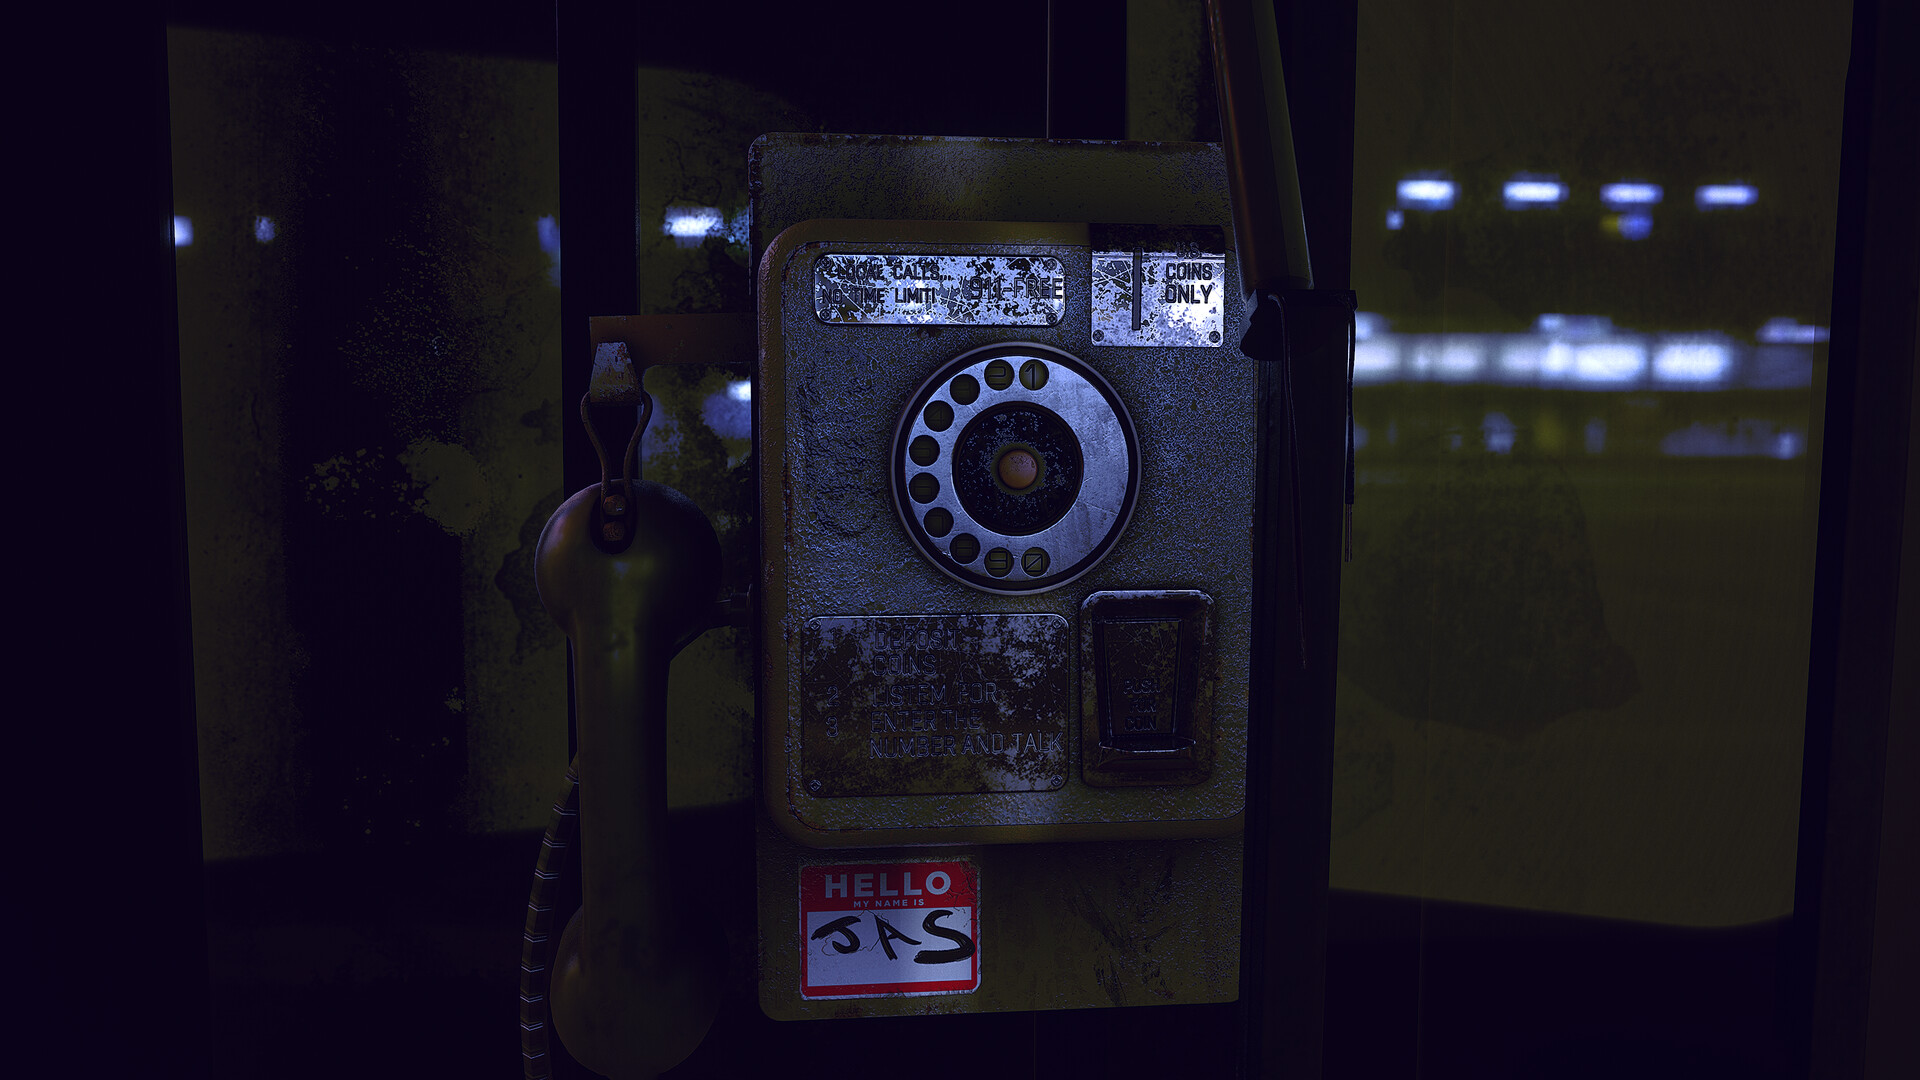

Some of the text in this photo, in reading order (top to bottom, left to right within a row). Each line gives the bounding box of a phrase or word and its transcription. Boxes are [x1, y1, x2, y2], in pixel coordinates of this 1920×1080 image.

[837, 264, 884, 280] LOCAL
[1166, 263, 1213, 280] COINS
[822, 288, 843, 304] NO
[854, 288, 885, 304] TIME
[969, 276, 1063, 300] 911-FREE
[1166, 284, 1212, 304] ONLY
[987, 366, 1006, 386] 2
[1025, 364, 1037, 389] 1
[989, 551, 1008, 570] 9
[874, 627, 961, 651] DEPOSIT
[873, 653, 936, 676] COINS
[826, 685, 839, 707] 2
[958, 681, 997, 704] FOR
[1123, 678, 1161, 694] PUSH
[826, 707, 982, 737] 3 ENTER THE
[1124, 715, 1157, 731] COIN
[869, 729, 1065, 759] NUMBER AND TALK
[825, 871, 951, 898] HELLO
[875, 899, 908, 907] NAME
[811, 909, 976, 964] JAS
